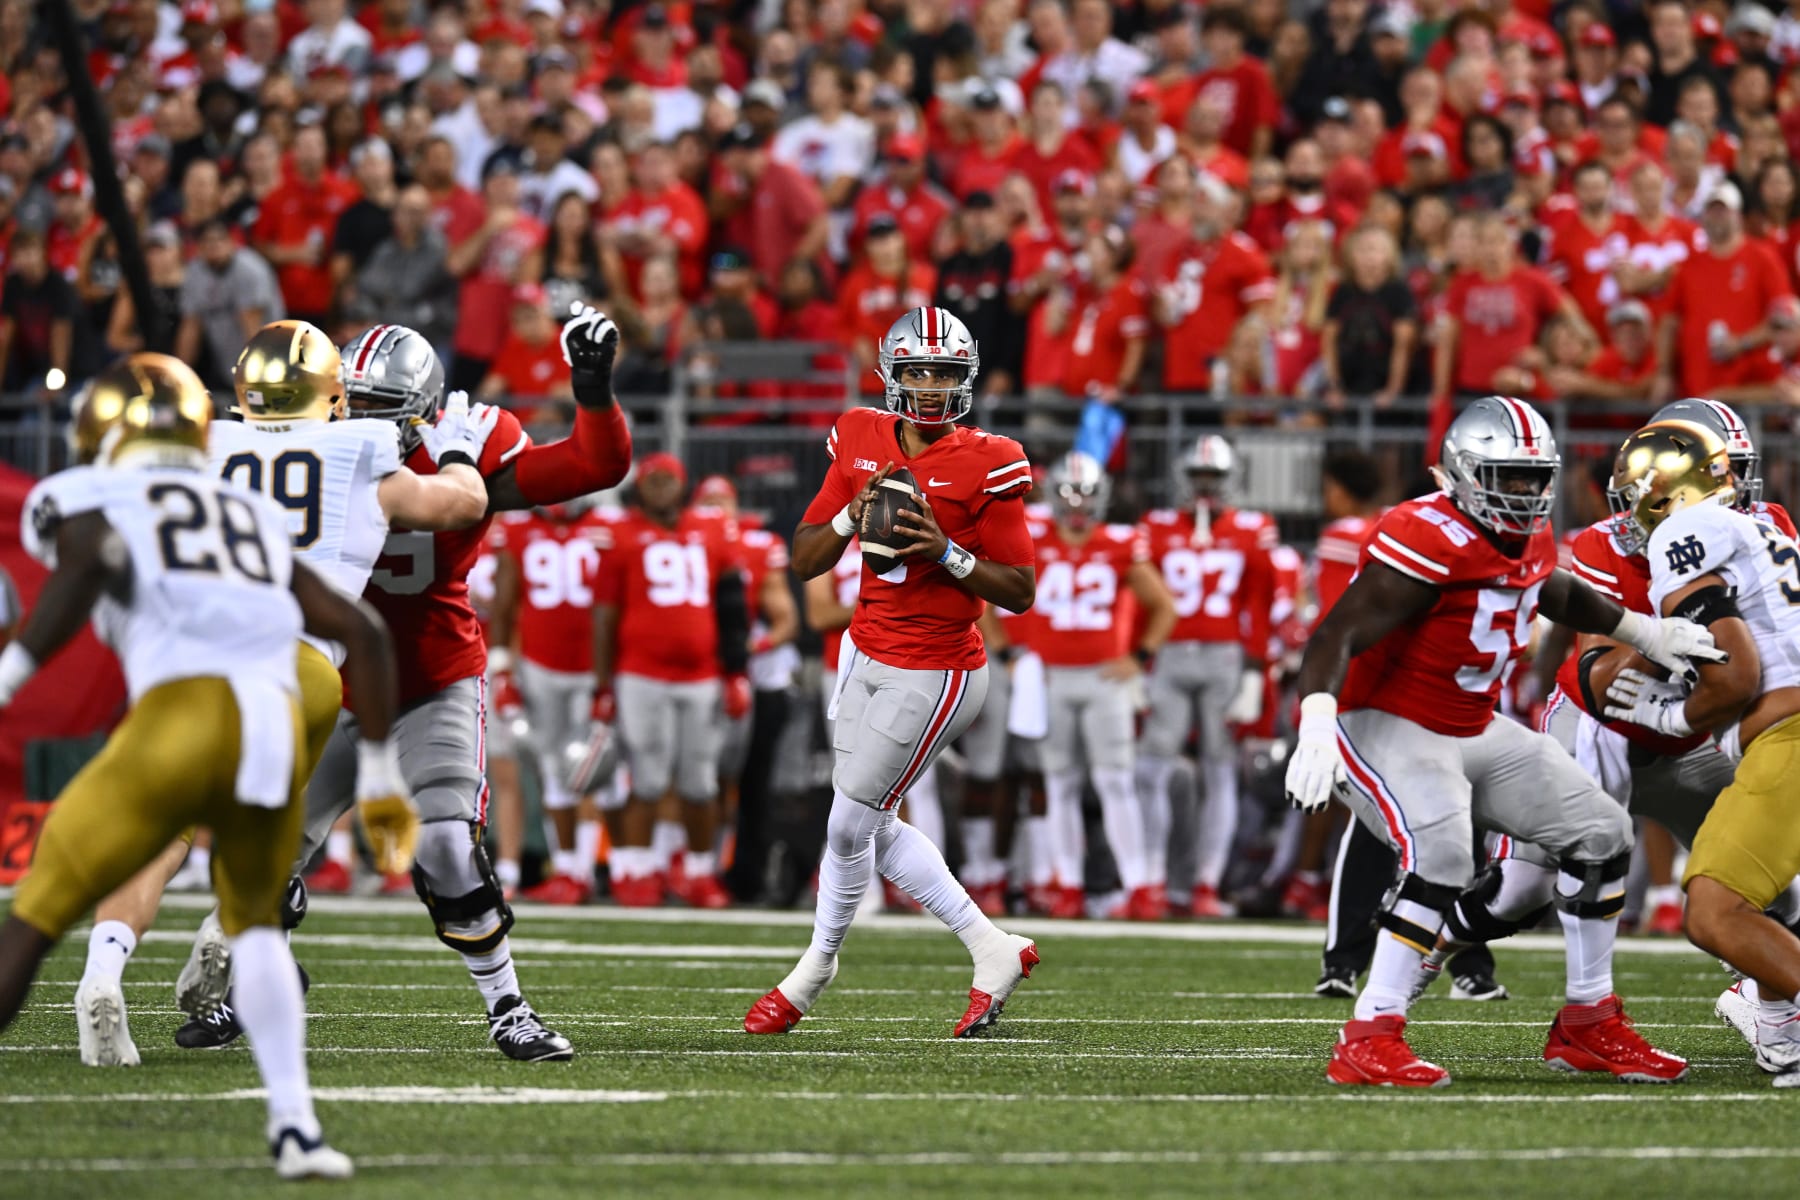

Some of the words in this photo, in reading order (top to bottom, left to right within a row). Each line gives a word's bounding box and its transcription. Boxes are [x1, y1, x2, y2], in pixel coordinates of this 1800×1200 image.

[148, 482, 273, 584] 28
[522, 536, 602, 611] 90
[642, 539, 711, 608] 91
[1033, 560, 1118, 632] 42
[1161, 549, 1245, 619] 97
